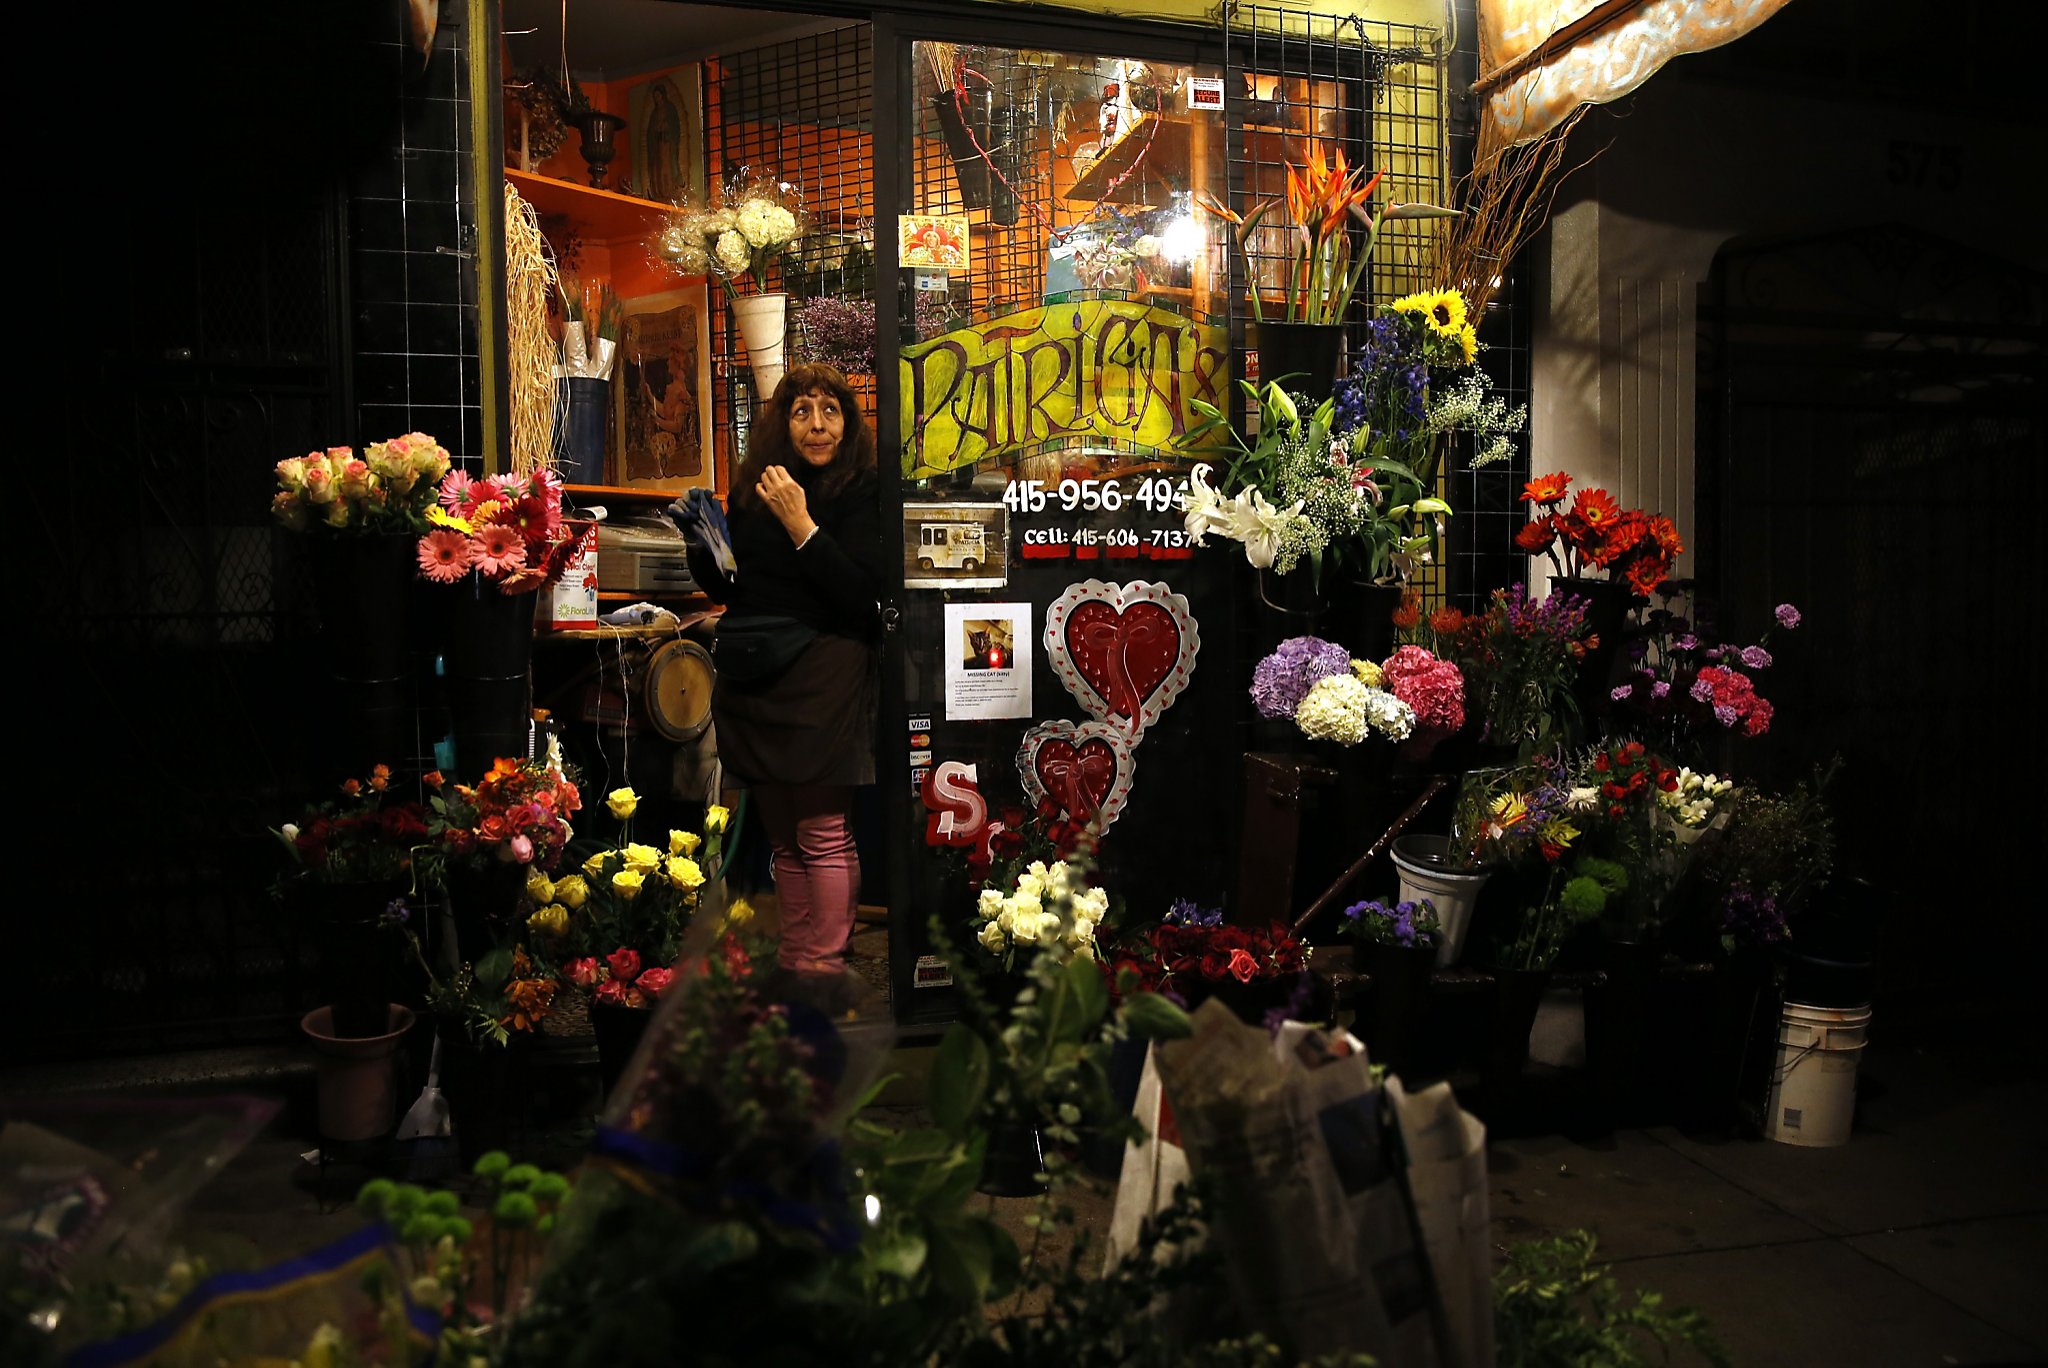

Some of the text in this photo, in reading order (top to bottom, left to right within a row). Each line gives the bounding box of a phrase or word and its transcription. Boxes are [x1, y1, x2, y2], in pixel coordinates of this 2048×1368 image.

[1887, 141, 1963, 192] 575
[1002, 477, 1189, 512] 415-956-494
[911, 720, 930, 729] VISA
